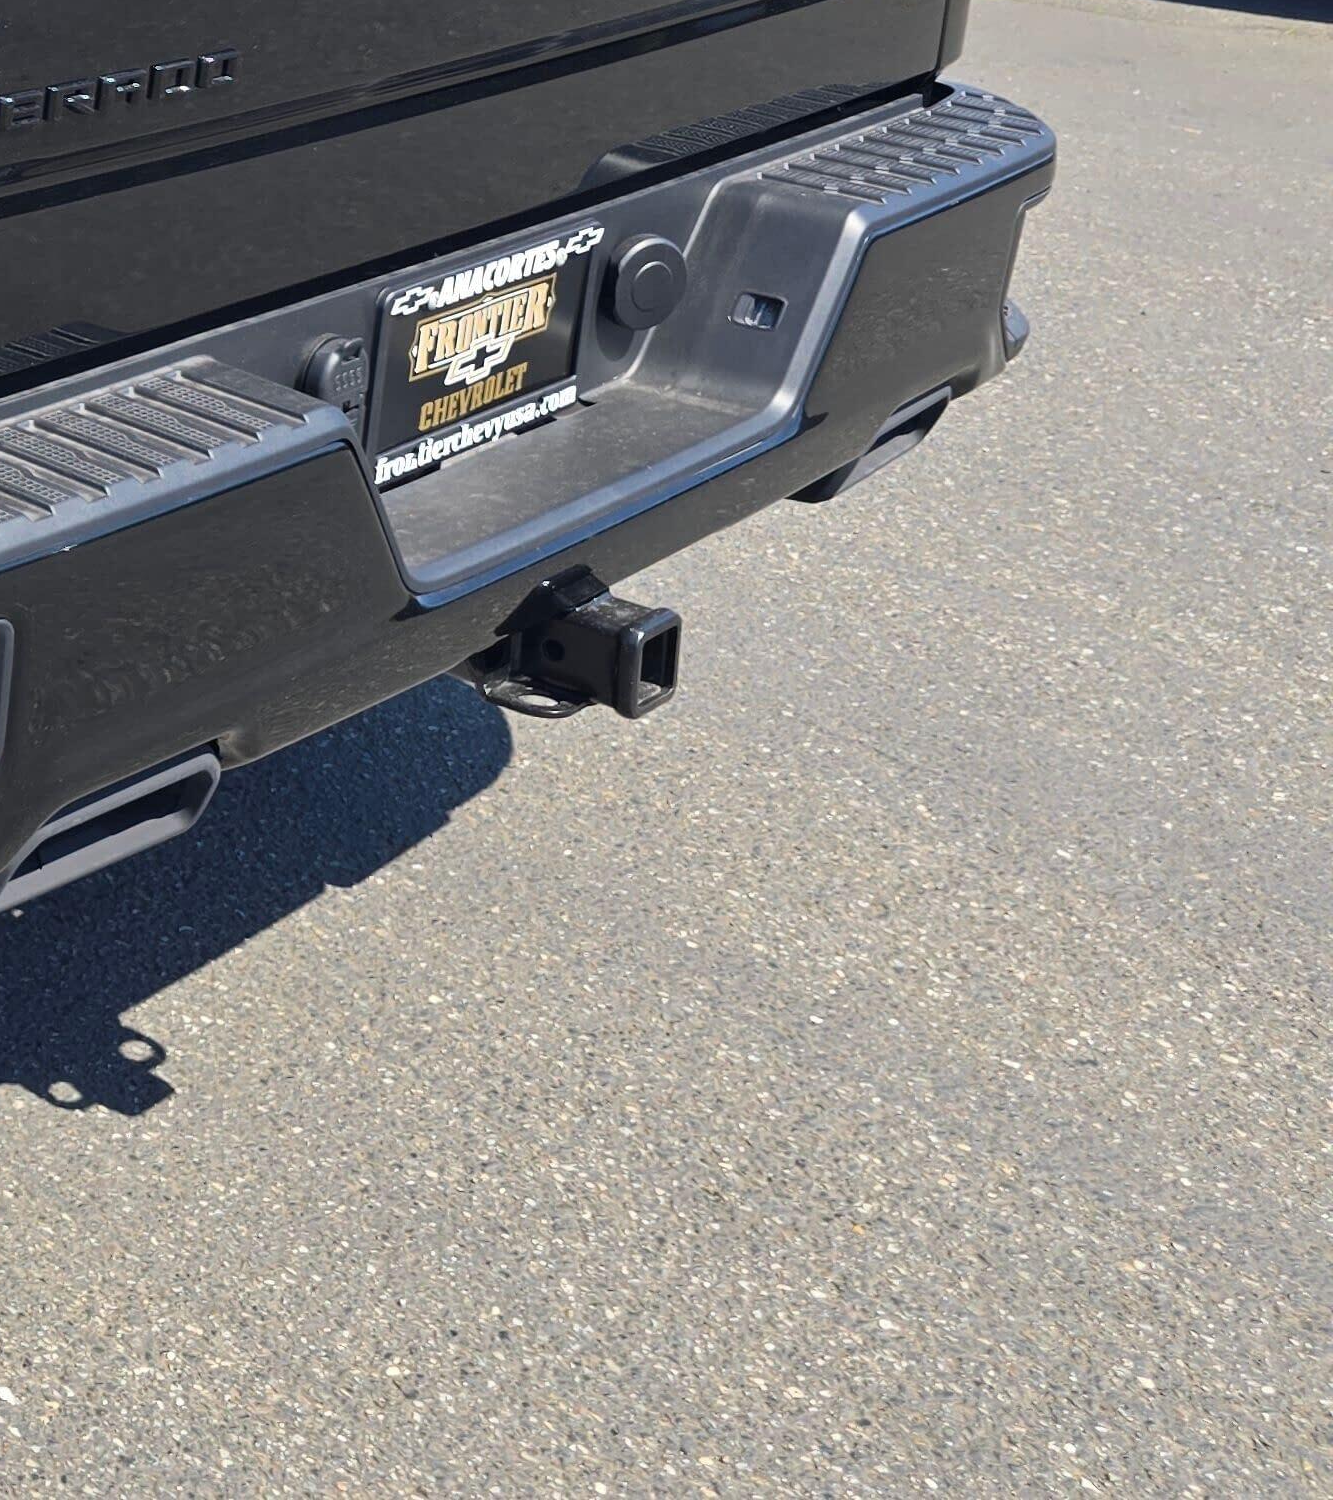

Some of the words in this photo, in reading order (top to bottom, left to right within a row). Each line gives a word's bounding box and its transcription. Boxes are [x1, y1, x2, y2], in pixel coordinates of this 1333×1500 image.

[436, 239, 560, 308] ANACORTES
[414, 282, 550, 374] FRONTIER
[373, 385, 577, 485] frontierchevyusa.com
[418, 361, 528, 432] CHEVROLET
